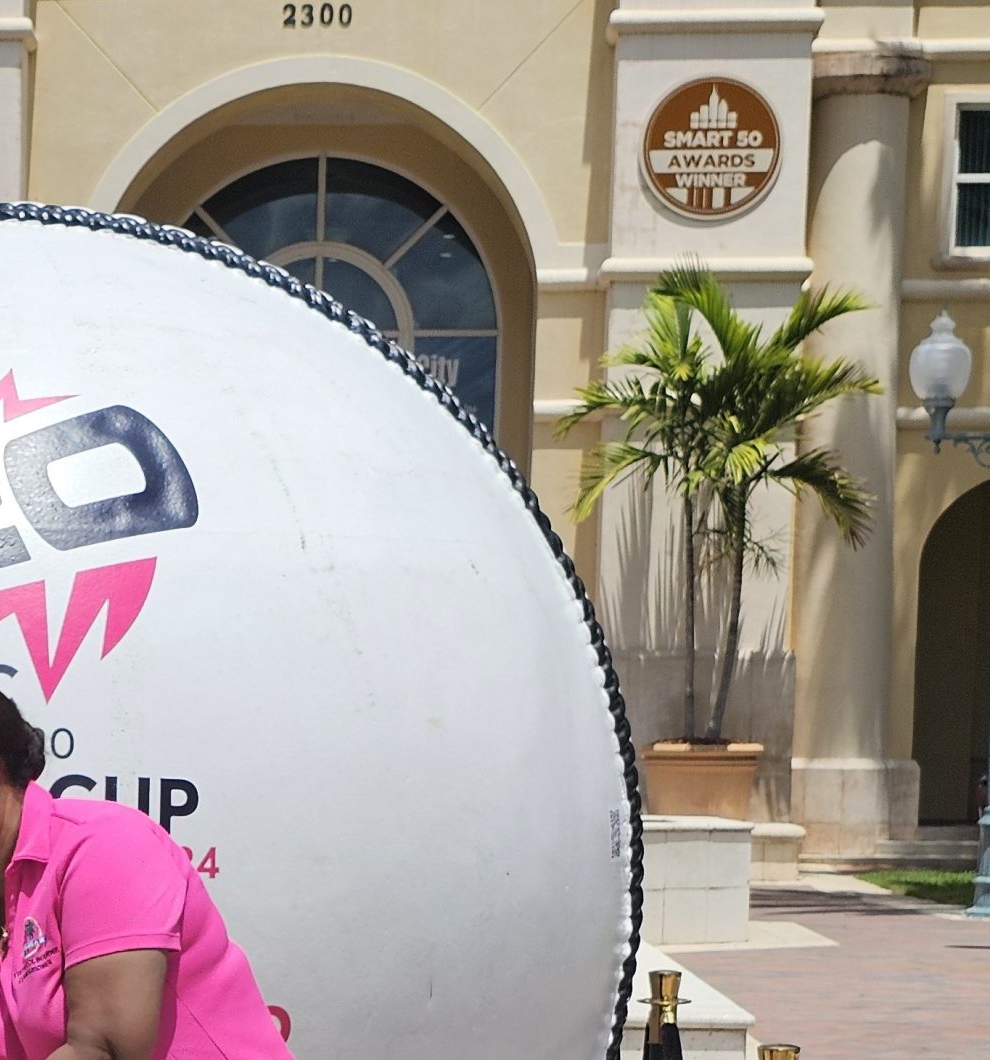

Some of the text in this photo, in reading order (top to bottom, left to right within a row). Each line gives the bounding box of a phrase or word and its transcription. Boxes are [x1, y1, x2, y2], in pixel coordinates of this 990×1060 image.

[282, 3, 352, 27] 2300
[663, 130, 763, 148] SMART 50
[668, 153, 755, 169] AWARDS
[675, 173, 747, 188] WINNER
